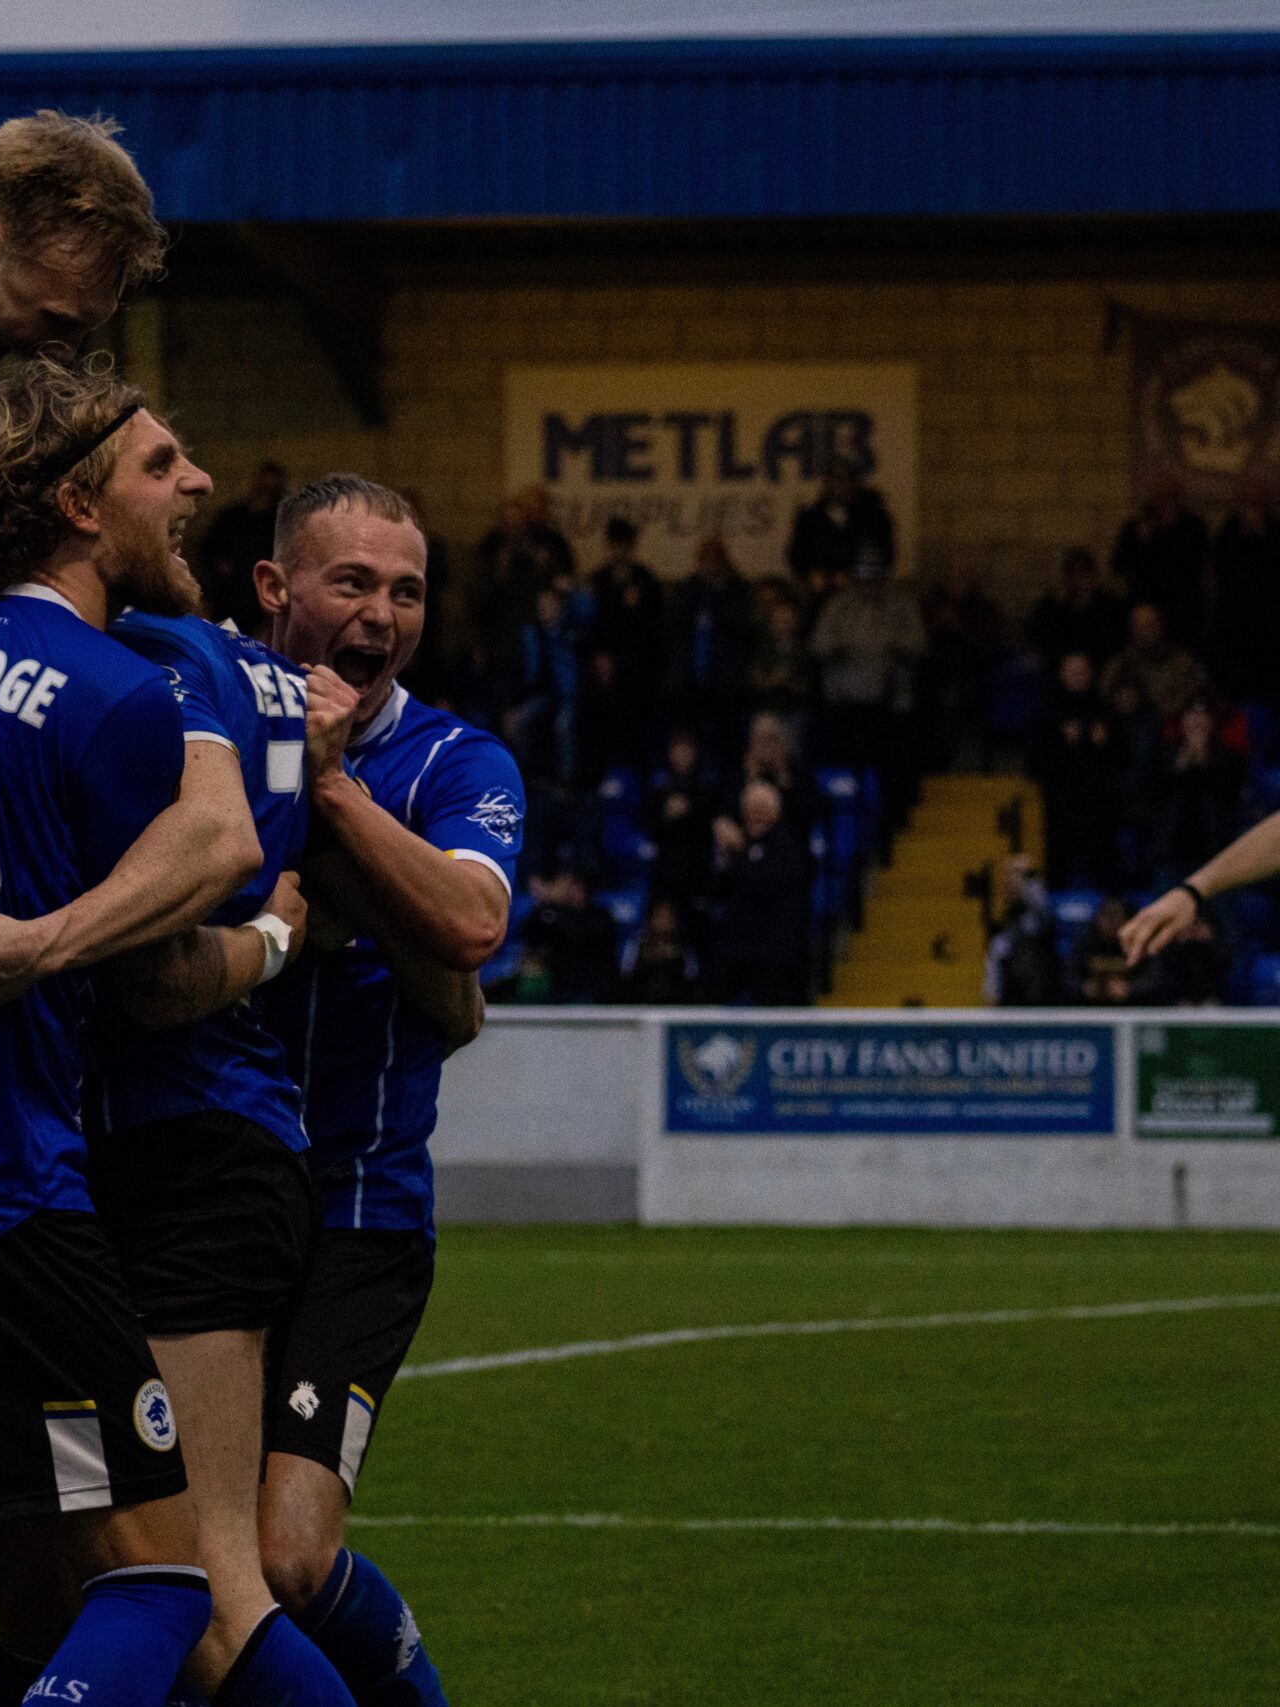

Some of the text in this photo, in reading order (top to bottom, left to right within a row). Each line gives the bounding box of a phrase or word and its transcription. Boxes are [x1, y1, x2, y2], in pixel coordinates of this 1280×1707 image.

[544, 411, 875, 481] METLAB
[767, 1039, 1099, 1077] CITY FANS UNITED
